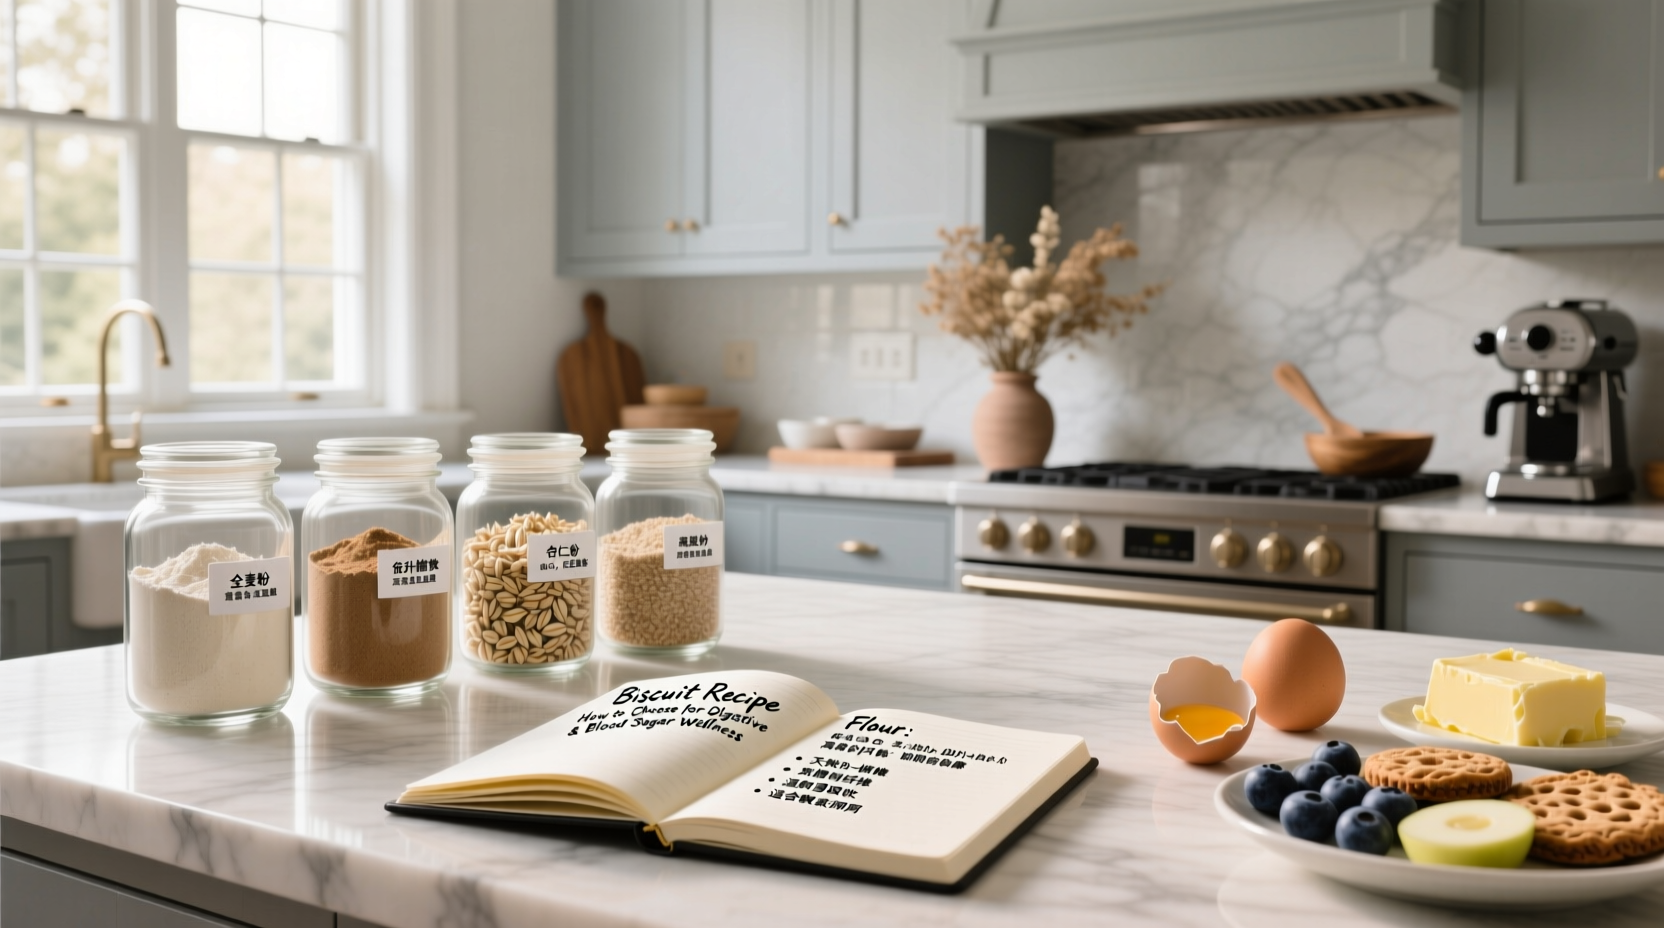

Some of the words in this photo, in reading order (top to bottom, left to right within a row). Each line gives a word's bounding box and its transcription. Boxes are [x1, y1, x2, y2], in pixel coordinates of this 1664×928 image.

[612, 683, 701, 705] Biscuit
[702, 682, 780, 714] Recipe
[577, 710, 609, 723] How
[844, 715, 914, 738] Flour:
